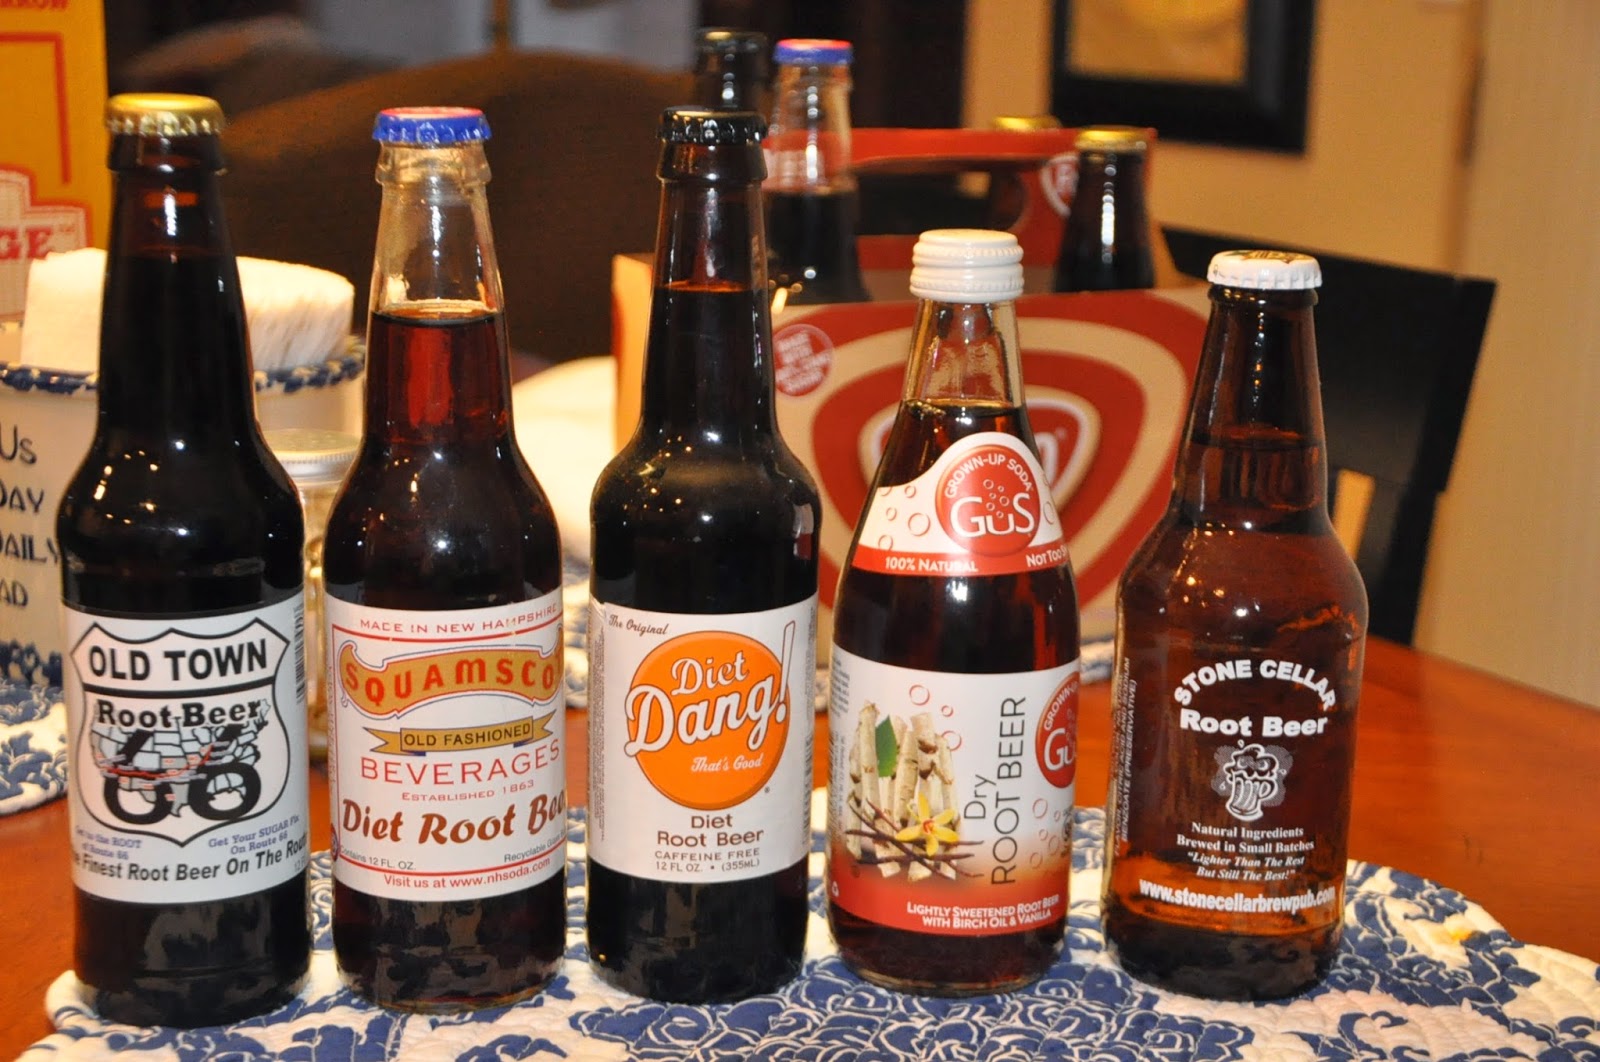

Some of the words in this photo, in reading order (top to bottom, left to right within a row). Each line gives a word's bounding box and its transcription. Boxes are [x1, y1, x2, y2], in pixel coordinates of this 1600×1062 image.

[945, 453, 1006, 499] GROWN-UP
[1006, 457, 1034, 493] SODA
[885, 556, 916, 571] 100%
[918, 557, 979, 573] NATURAL
[360, 618, 403, 633] MADE
[410, 623, 428, 633] IN
[436, 622, 476, 634] NEW
[482, 602, 558, 631] HAMPSHIRE
[625, 618, 670, 637] Original
[89, 645, 150, 681] OLD
[163, 638, 268, 682] TOWN
[344, 656, 560, 708] SQUAMSCO
[671, 650, 750, 696] Diet
[1174, 659, 1253, 707] STONE
[1259, 659, 1337, 712] CELLAR
[97, 699, 172, 728] Root
[181, 699, 262, 728] Beer
[1179, 708, 1253, 738] Root
[1261, 715, 1329, 738] Beer
[404, 732, 437, 747] OLD
[443, 722, 532, 746] FASHIONED
[997, 697, 1026, 780] BEER
[360, 739, 561, 786] BEVERAGES
[733, 753, 764, 770] Good
[401, 789, 496, 802] ESTABLISHED
[502, 779, 535, 795] 1863
[963, 774, 997, 820] Dry
[208, 837, 230, 848] Get
[231, 832, 257, 846] Your
[256, 818, 289, 840] SUGAR
[342, 798, 404, 843] Diet
[418, 803, 516, 845] Root
[690, 813, 733, 830] Diet
[1191, 821, 1238, 838] Natural
[1241, 825, 1304, 842] Ingredients
[111, 836, 142, 849] ROOT
[230, 845, 247, 855] On
[248, 836, 277, 852] Route
[657, 830, 707, 848] Root
[716, 829, 765, 847] Beer
[991, 791, 1020, 885] ROOT
[1176, 834, 1222, 851] Brewed
[1224, 841, 1236, 852] in
[1238, 841, 1273, 854] Small
[1275, 839, 1315, 854] Batches
[128, 862, 169, 881] Root
[175, 860, 220, 881] Beer
[226, 857, 250, 876] On
[256, 849, 283, 869] The
[369, 856, 379, 866] 12
[504, 843, 547, 863] Recyclable
[655, 850, 722, 862] CAFFEINE
[728, 847, 761, 859] FREE
[1234, 855, 1262, 868] Than
[1264, 856, 1283, 868] The
[1285, 855, 1305, 867] Rest
[384, 873, 411, 889] Visit
[413, 877, 430, 889] us
[432, 874, 447, 889] at
[449, 857, 551, 888] www.nhsoda.com
[655, 861, 667, 871] 12
[670, 861, 683, 872] FL
[721, 858, 761, 873] (355ML)
[1195, 866, 1216, 879] But
[1217, 867, 1240, 881] Still
[1243, 869, 1262, 882] The
[906, 901, 951, 917] LIGHTLY
[952, 905, 1016, 918] SWEETENED
[1016, 900, 1043, 915] ROOT
[1138, 879, 1337, 915] www.stonecellarbrewpub.com
[922, 915, 951, 928] WITH
[952, 916, 988, 929] BIRCH
[989, 916, 1008, 929] OIL
[1009, 917, 1017, 927] &
[1017, 909, 1052, 925] VANILLA
